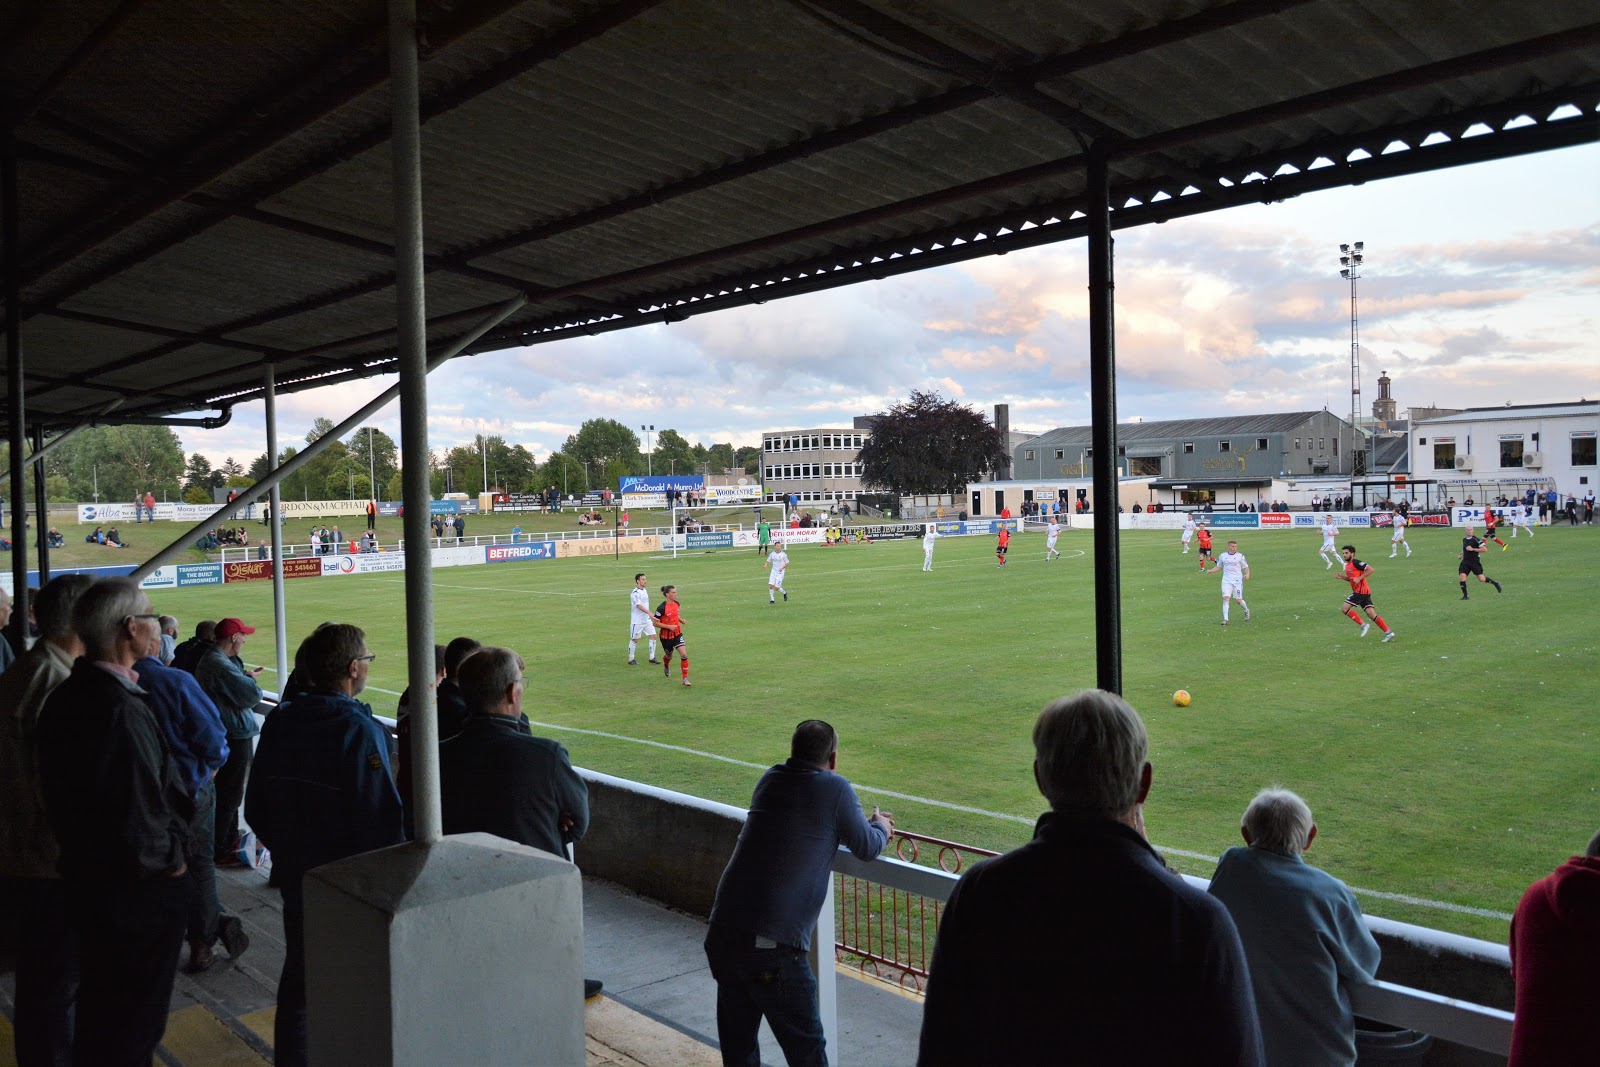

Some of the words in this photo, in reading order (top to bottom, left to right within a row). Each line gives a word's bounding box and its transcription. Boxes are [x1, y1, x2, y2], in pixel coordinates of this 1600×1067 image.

[1060, 463, 1089, 476] G&M
[634, 483, 665, 492] McDonald
[715, 488, 754, 497] WOODCENTRE
[98, 505, 120, 518] Alba
[1423, 514, 1450, 525] COLA
[841, 527, 866, 535] LITT
[867, 526, 882, 534] THE
[882, 524, 921, 533] JEWELLERS
[489, 547, 532, 559] BETFRED
[178, 565, 220, 573] TRANSFORMING
[323, 562, 340, 571] bell
[180, 577, 219, 585] ENVIRONMENT
